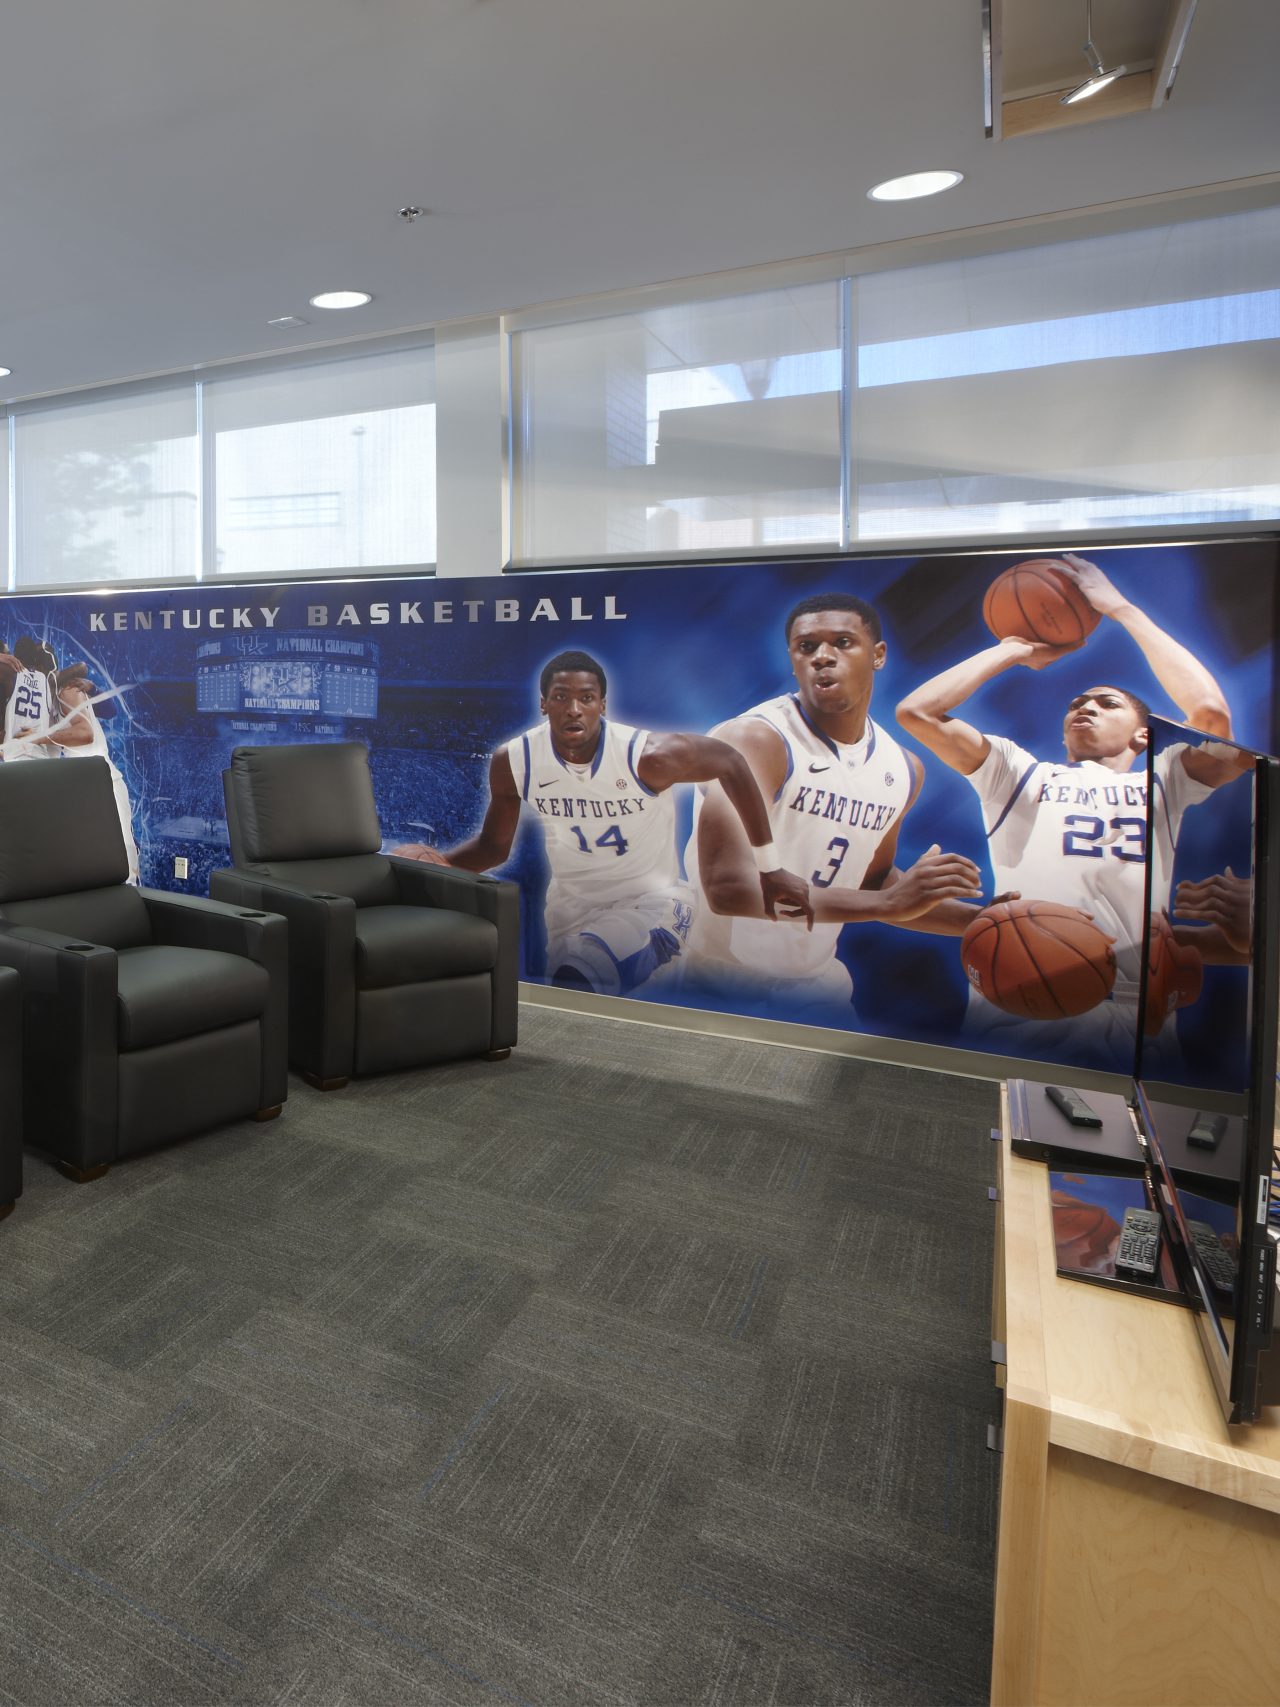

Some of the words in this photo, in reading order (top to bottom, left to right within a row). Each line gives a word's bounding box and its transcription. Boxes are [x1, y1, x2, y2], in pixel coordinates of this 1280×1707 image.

[90, 606, 280, 631] KENTUCKY
[307, 596, 627, 626] BASKETBALL
[15, 686, 42, 720] 25
[535, 797, 645, 818] KENTUCKY
[789, 786, 896, 831] KENTUCKY
[570, 825, 628, 856] 14
[1063, 814, 1147, 863] 23
[811, 836, 849, 888] 3
